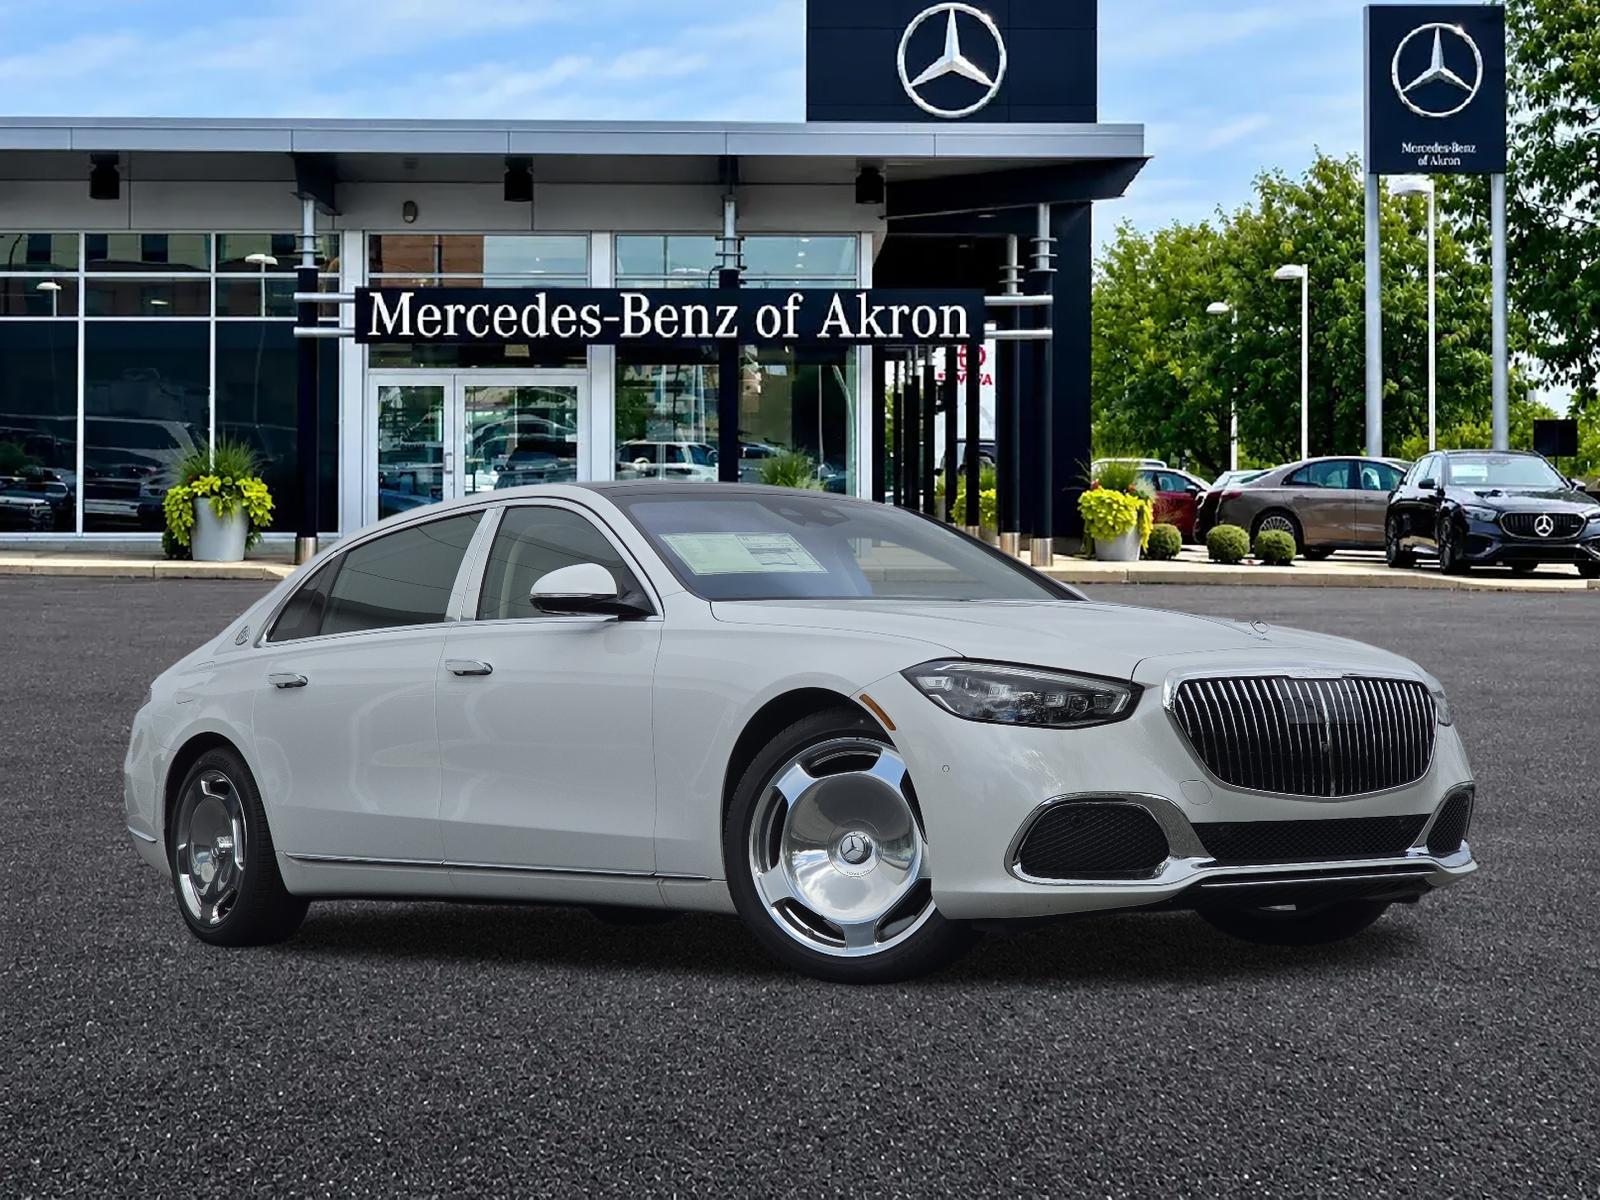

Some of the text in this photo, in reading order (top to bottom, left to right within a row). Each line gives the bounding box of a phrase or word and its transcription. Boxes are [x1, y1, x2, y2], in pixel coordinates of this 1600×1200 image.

[1401, 142, 1476, 153] Mercedes-Benz
[1417, 154, 1461, 165] of Akron
[367, 292, 970, 338] Mercedes-Benz of Akron
